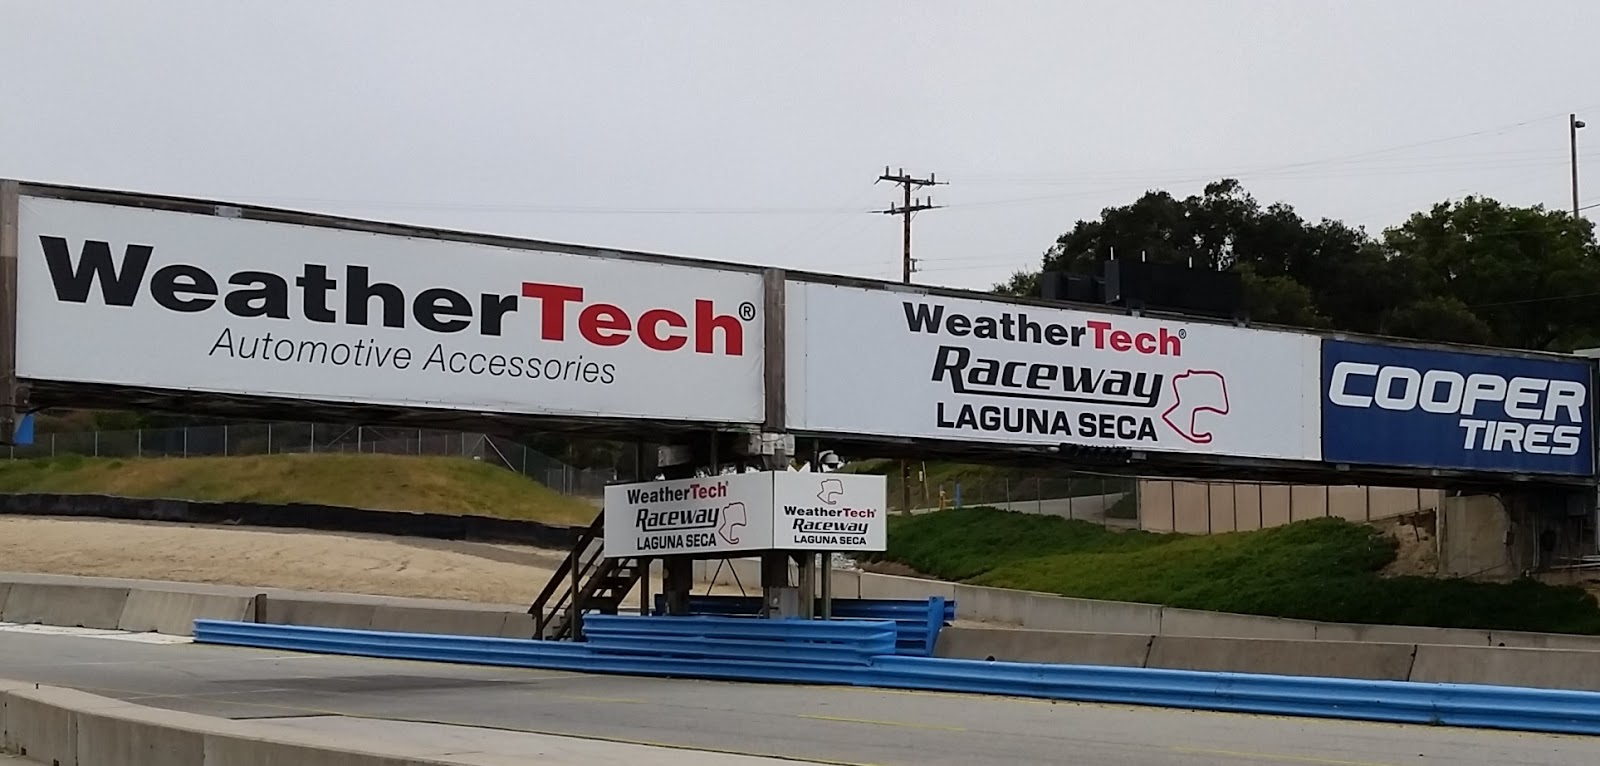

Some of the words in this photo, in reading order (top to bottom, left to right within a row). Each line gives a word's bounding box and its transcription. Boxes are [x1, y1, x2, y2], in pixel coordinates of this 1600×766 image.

[208, 327, 412, 369] Automotive
[422, 343, 616, 385] Accessories
[932, 346, 1164, 408] Raceway
[1328, 362, 1587, 423] COOPER
[937, 402, 1071, 437] LAGUNA
[1078, 412, 1159, 442] SECA
[1459, 418, 1582, 456] TIRES
[635, 507, 720, 533] Raceway
[792, 518, 869, 535] Raceway
[636, 534, 683, 550] LAGUNA
[686, 532, 717, 548] SECA
[794, 534, 838, 545] LAGUNA
[839, 535, 867, 545] SECA
